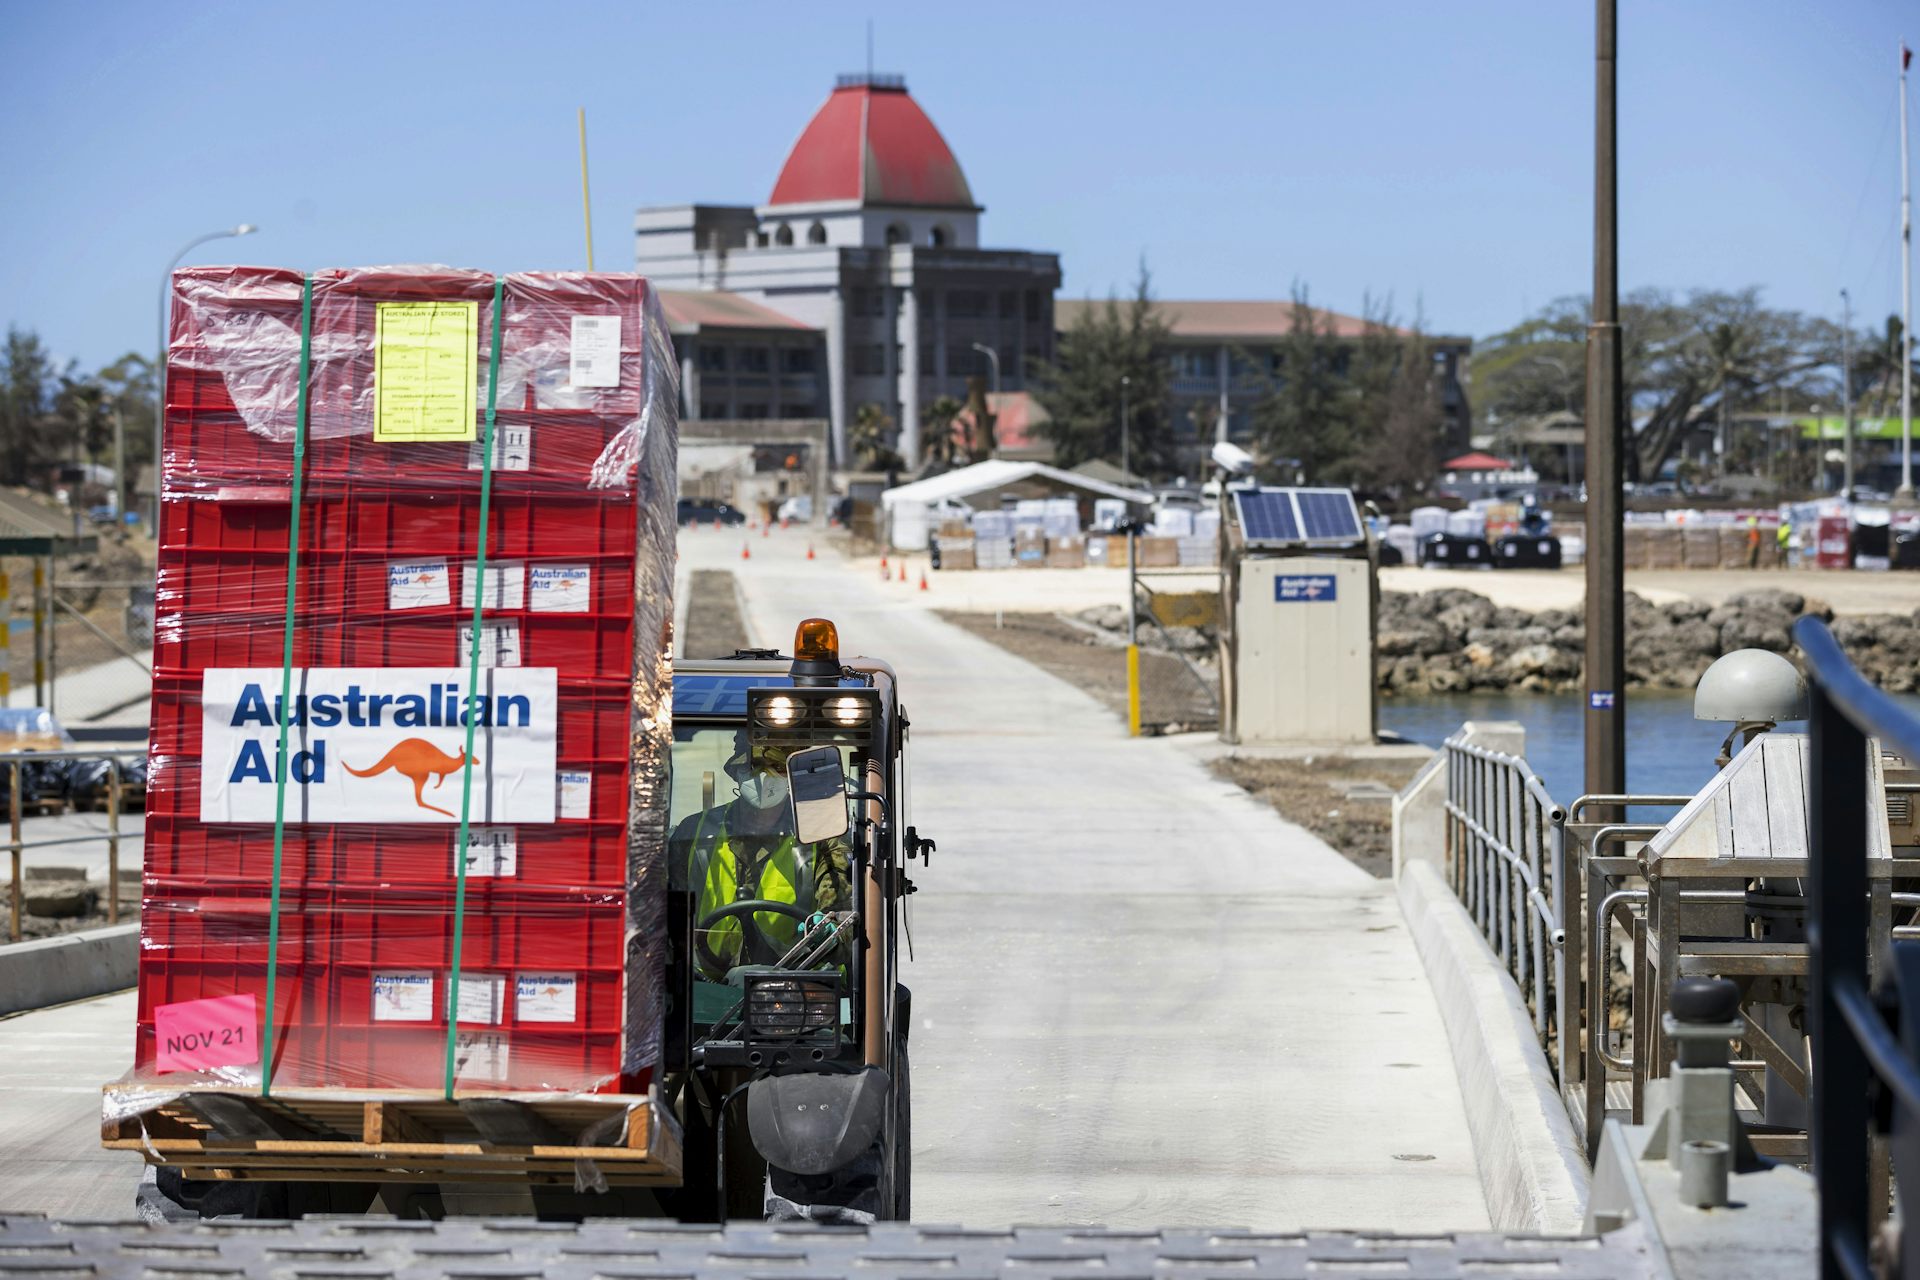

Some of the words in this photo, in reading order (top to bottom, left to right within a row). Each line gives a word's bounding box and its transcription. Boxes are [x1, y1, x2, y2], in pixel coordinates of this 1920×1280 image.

[390, 564, 445, 575] Australian
[531, 568, 587, 579] Australian
[390, 576, 409, 586] Aid
[531, 580, 550, 589] Aid
[230, 683, 530, 727] Australian
[374, 975, 430, 985] Australian
[518, 975, 573, 985] Australian
[517, 986, 536, 996] Aid
[167, 1030, 213, 1054] NOV
[221, 1026, 243, 1046] 21
